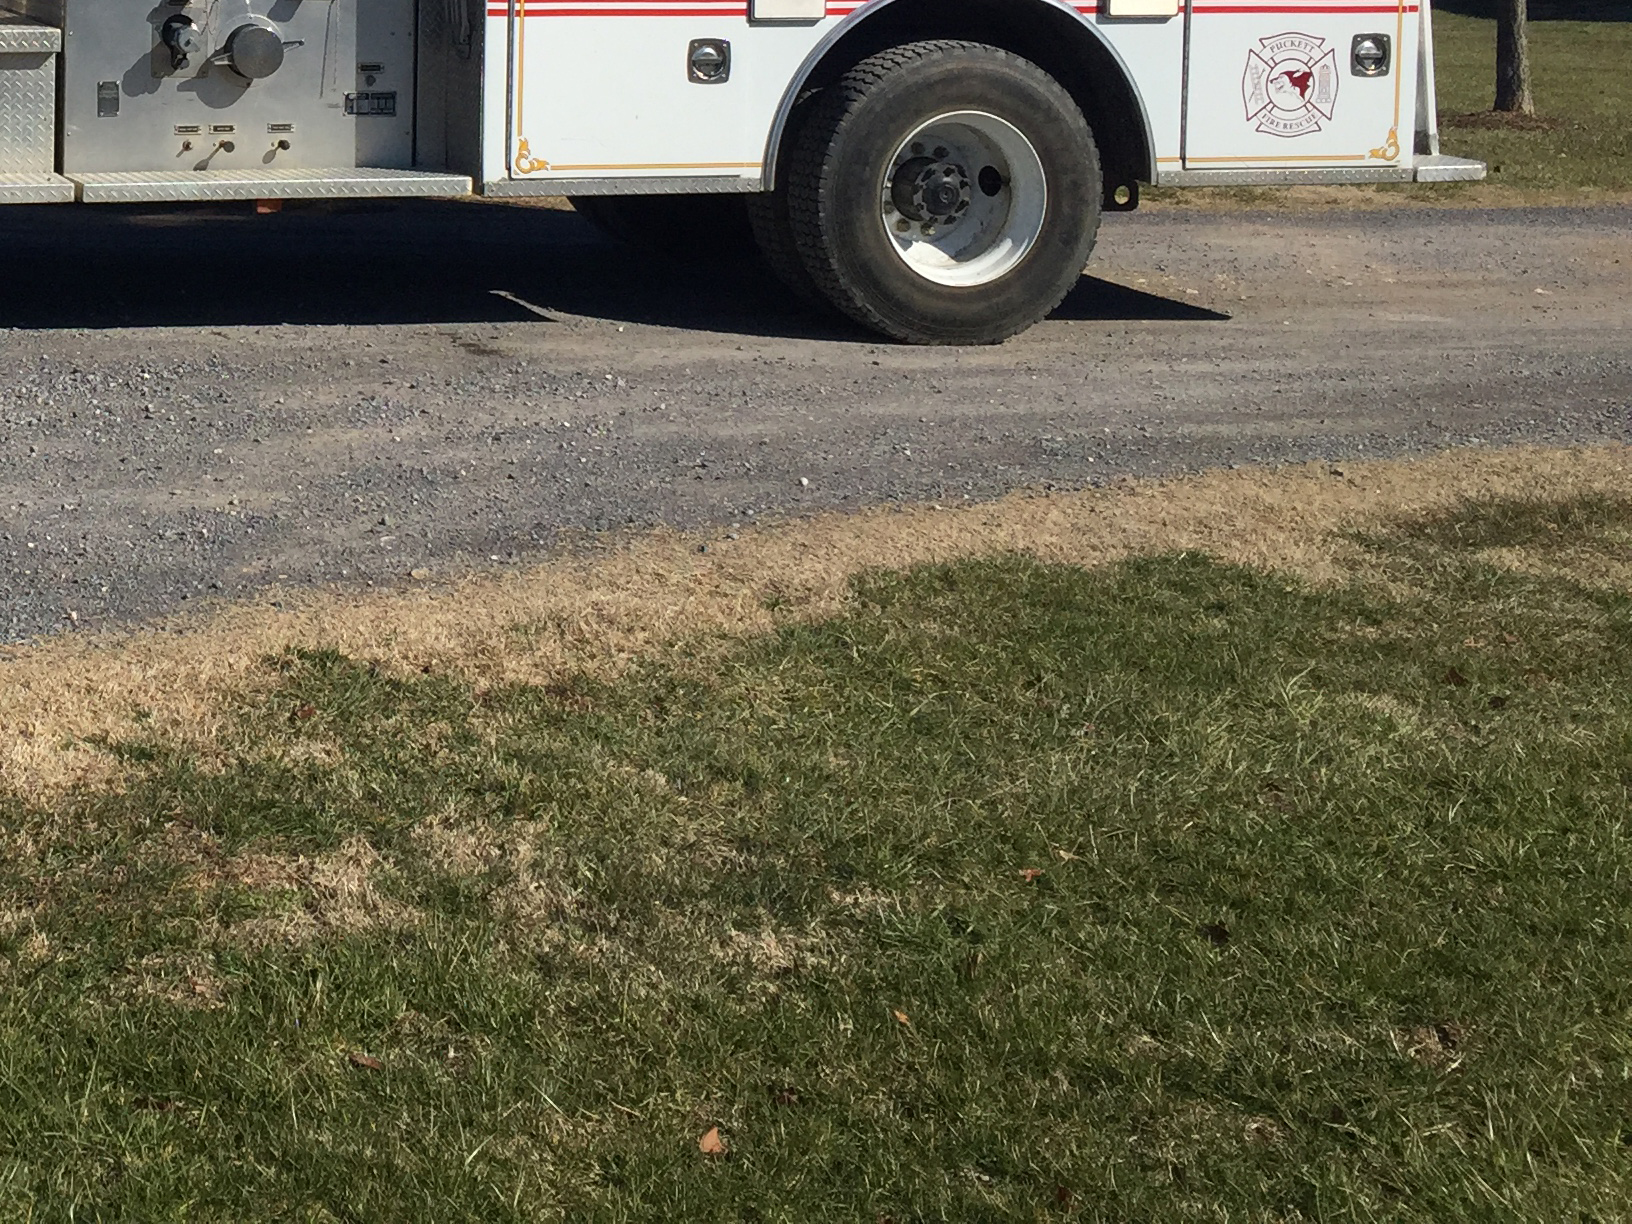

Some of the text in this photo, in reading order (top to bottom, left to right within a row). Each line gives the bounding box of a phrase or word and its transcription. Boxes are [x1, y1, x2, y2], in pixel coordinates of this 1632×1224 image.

[1270, 40, 1315, 53] PUCKETT
[1261, 113, 1316, 129] FIRE RESCUE
